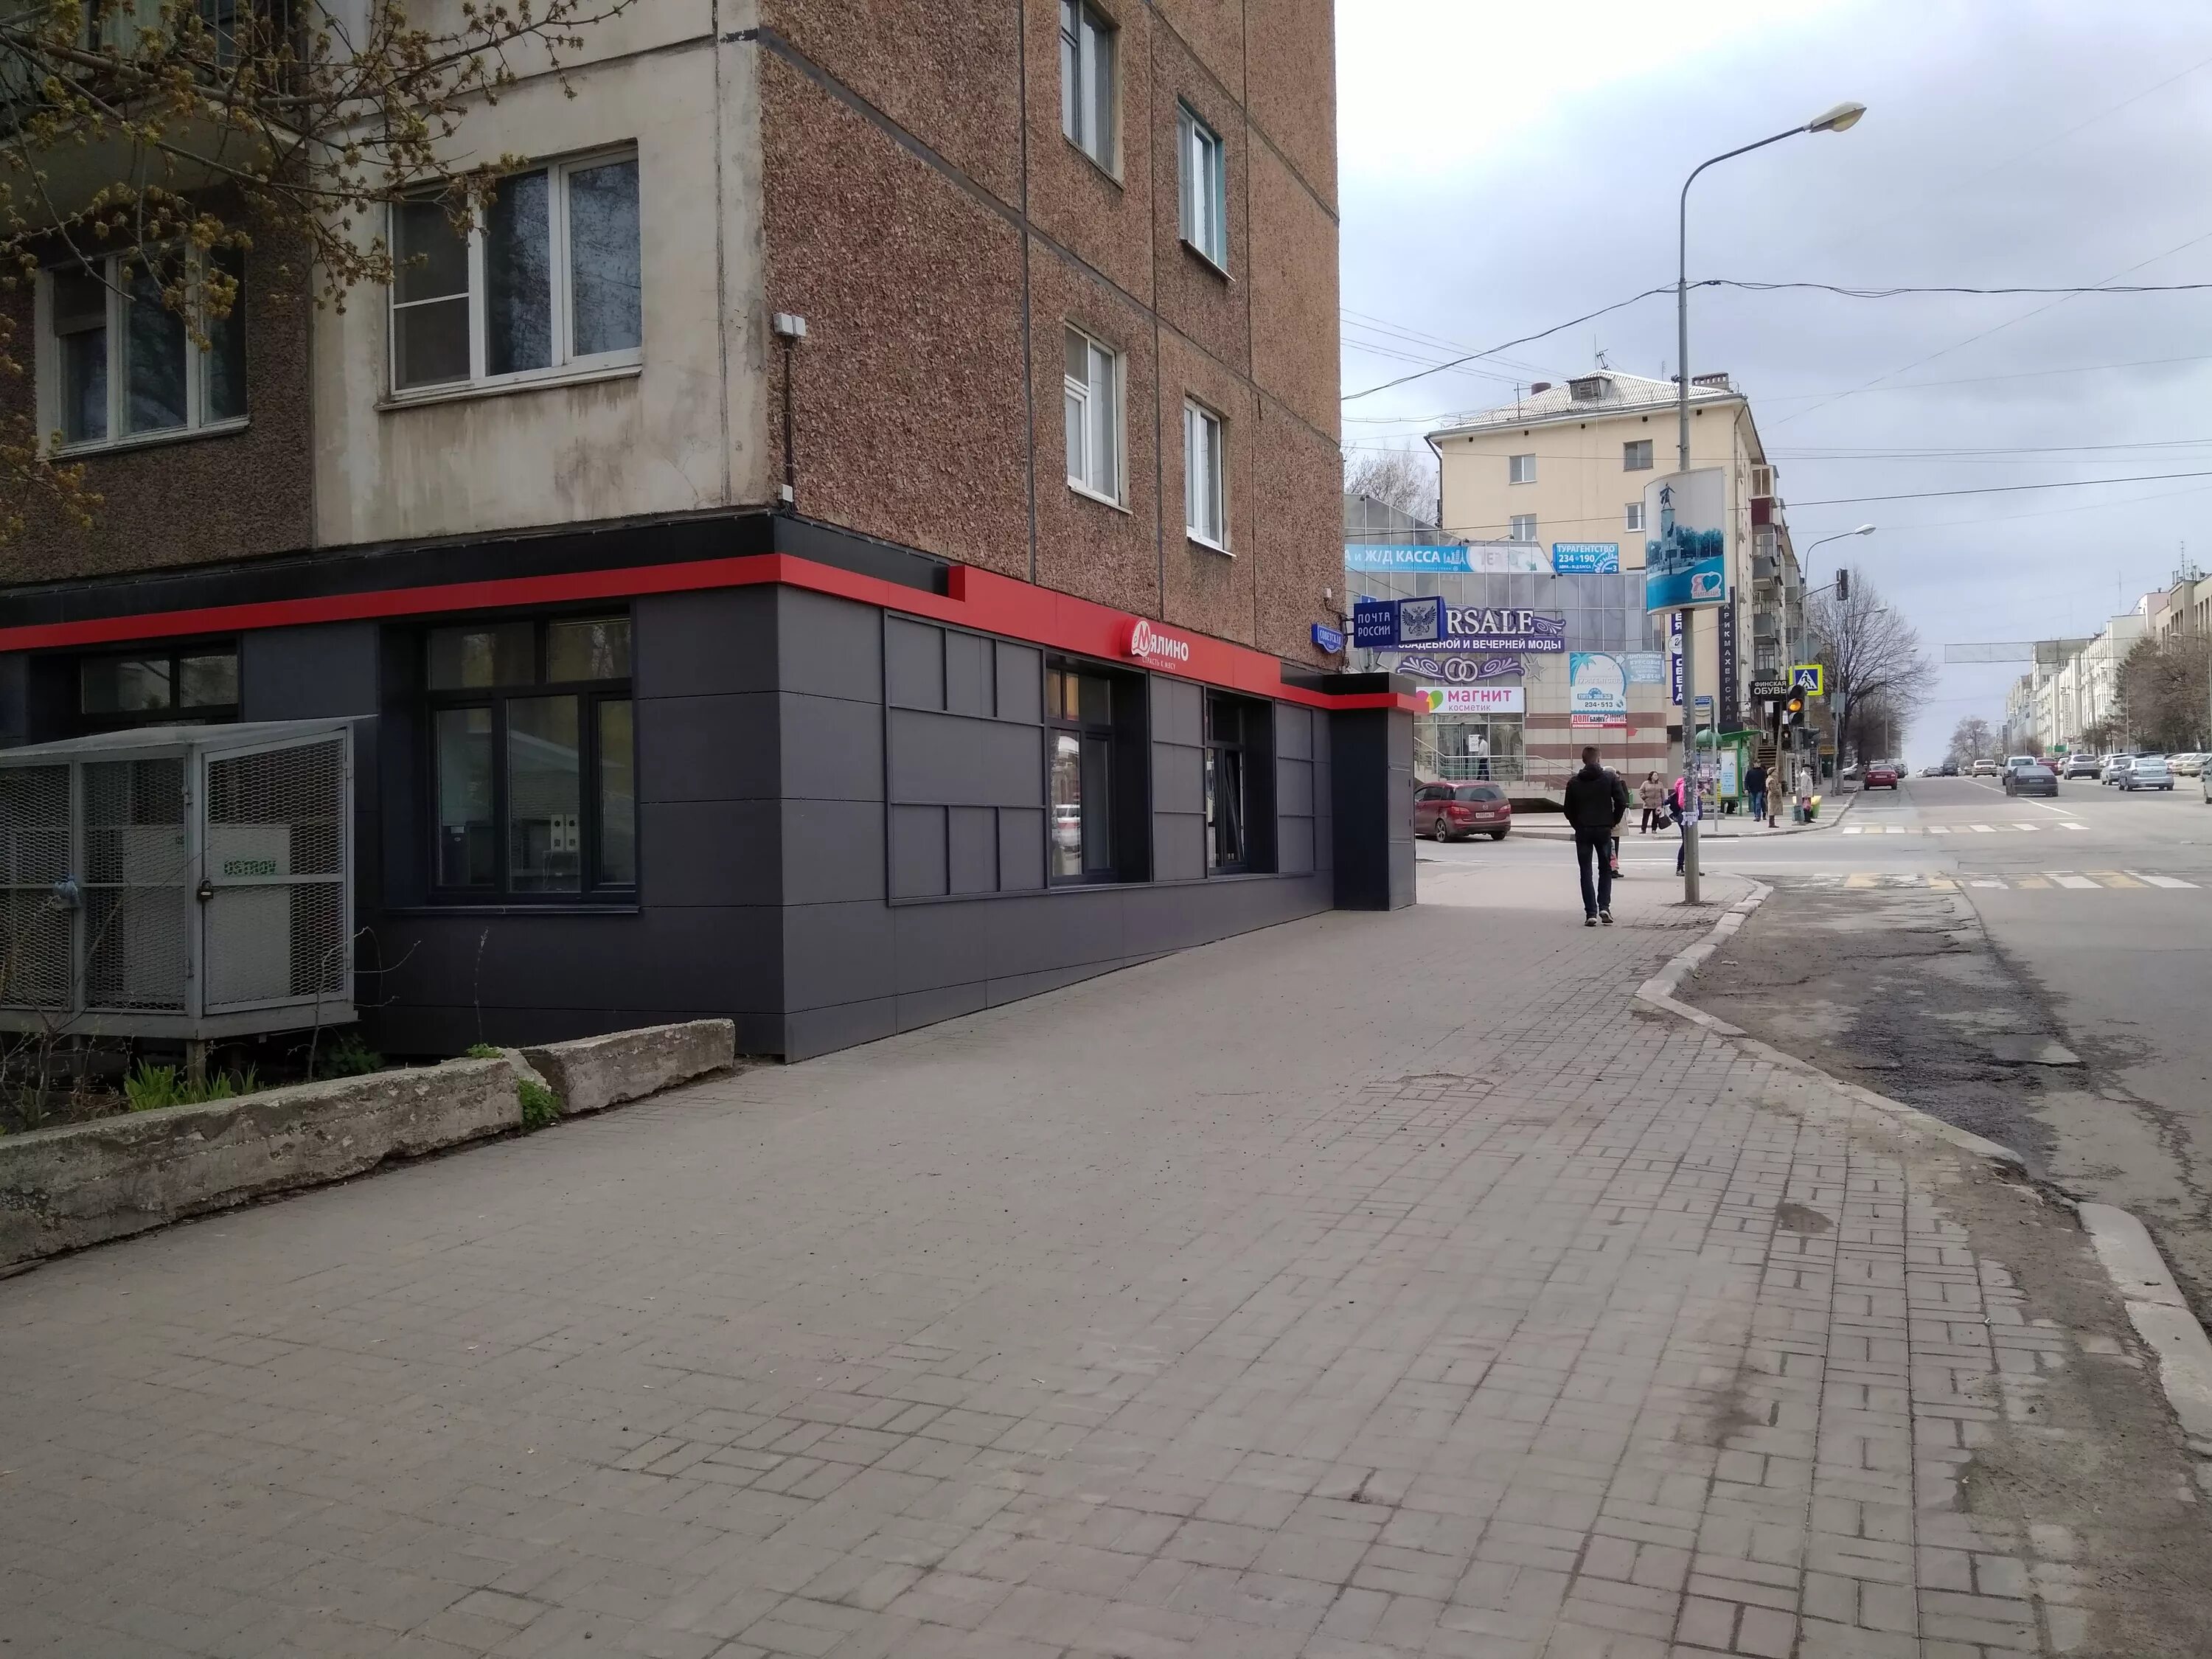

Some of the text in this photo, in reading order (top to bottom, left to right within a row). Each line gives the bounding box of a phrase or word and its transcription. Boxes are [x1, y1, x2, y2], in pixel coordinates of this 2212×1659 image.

[1557, 545, 1615, 553] ТУРАГЕНТСТВО
[1365, 549, 1393, 565] Ж/Д
[1396, 550, 1441, 563] КАССА
[1357, 612, 1391, 624] ПОЧТА
[1446, 610, 1534, 635] RSALE
[1358, 625, 1391, 637] РОССИИ
[1131, 621, 1189, 661] МЯЛИНО
[1320, 630, 1341, 645] СОВЕТСКАЯ
[1463, 640, 1470, 649] И
[1472, 639, 1526, 649] ВЕЧЕРНЕЙ
[1528, 640, 1561, 650] МОДЫ
[1754, 686, 1787, 695] ОБУВЬ
[1573, 714, 1590, 723] ДОЛГ
